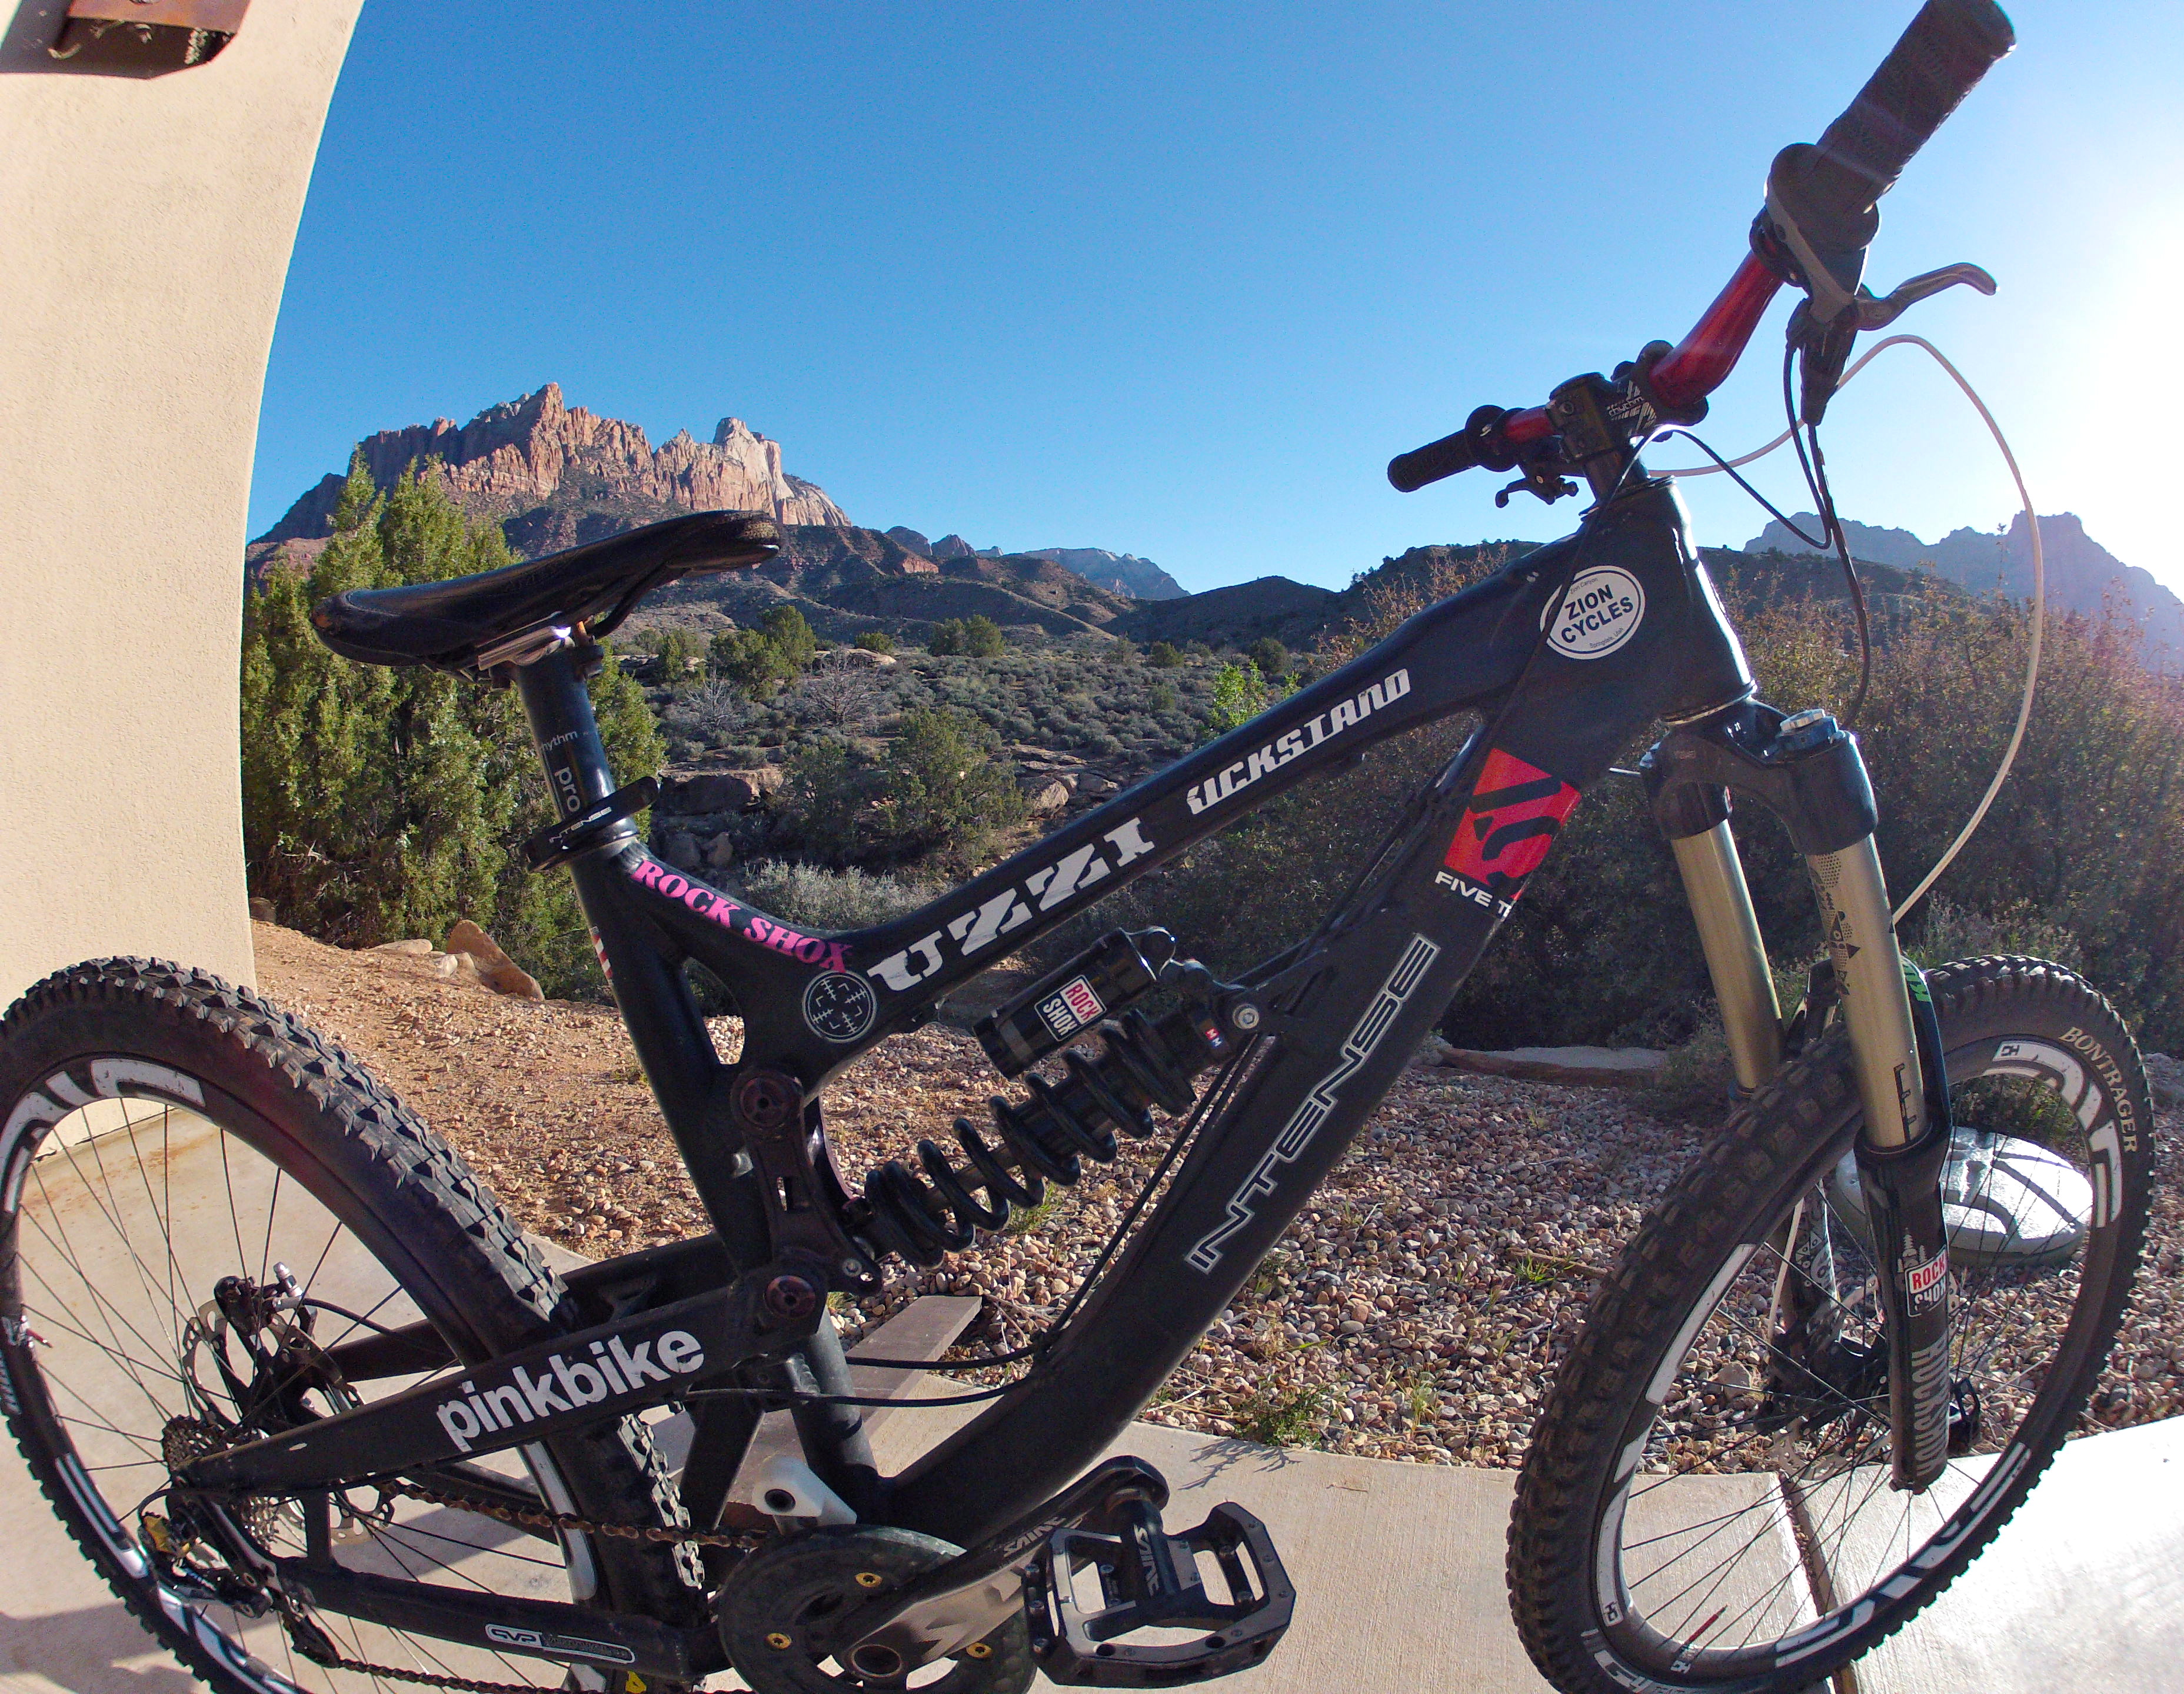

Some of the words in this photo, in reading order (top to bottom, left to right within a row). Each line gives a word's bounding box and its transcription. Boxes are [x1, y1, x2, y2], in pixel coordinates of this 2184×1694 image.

[1562, 596, 1633, 643] CYCLES
[1564, 585, 1613, 621] ZION
[555, 766, 580, 812] pro
[868, 817, 1154, 992] UZZI
[1434, 871, 1493, 908] FIVE
[631, 859, 741, 927] ROCK
[743, 917, 853, 973] SHOX
[1043, 998, 1078, 1036] SHOX
[1064, 982, 1097, 1021] ROCK
[1184, 933, 1441, 1274] INTENSE
[2059, 1026, 2138, 1153] BONTRAGER
[1912, 1251, 1946, 1290] ROCK
[437, 1330, 705, 1452] pinkbike
